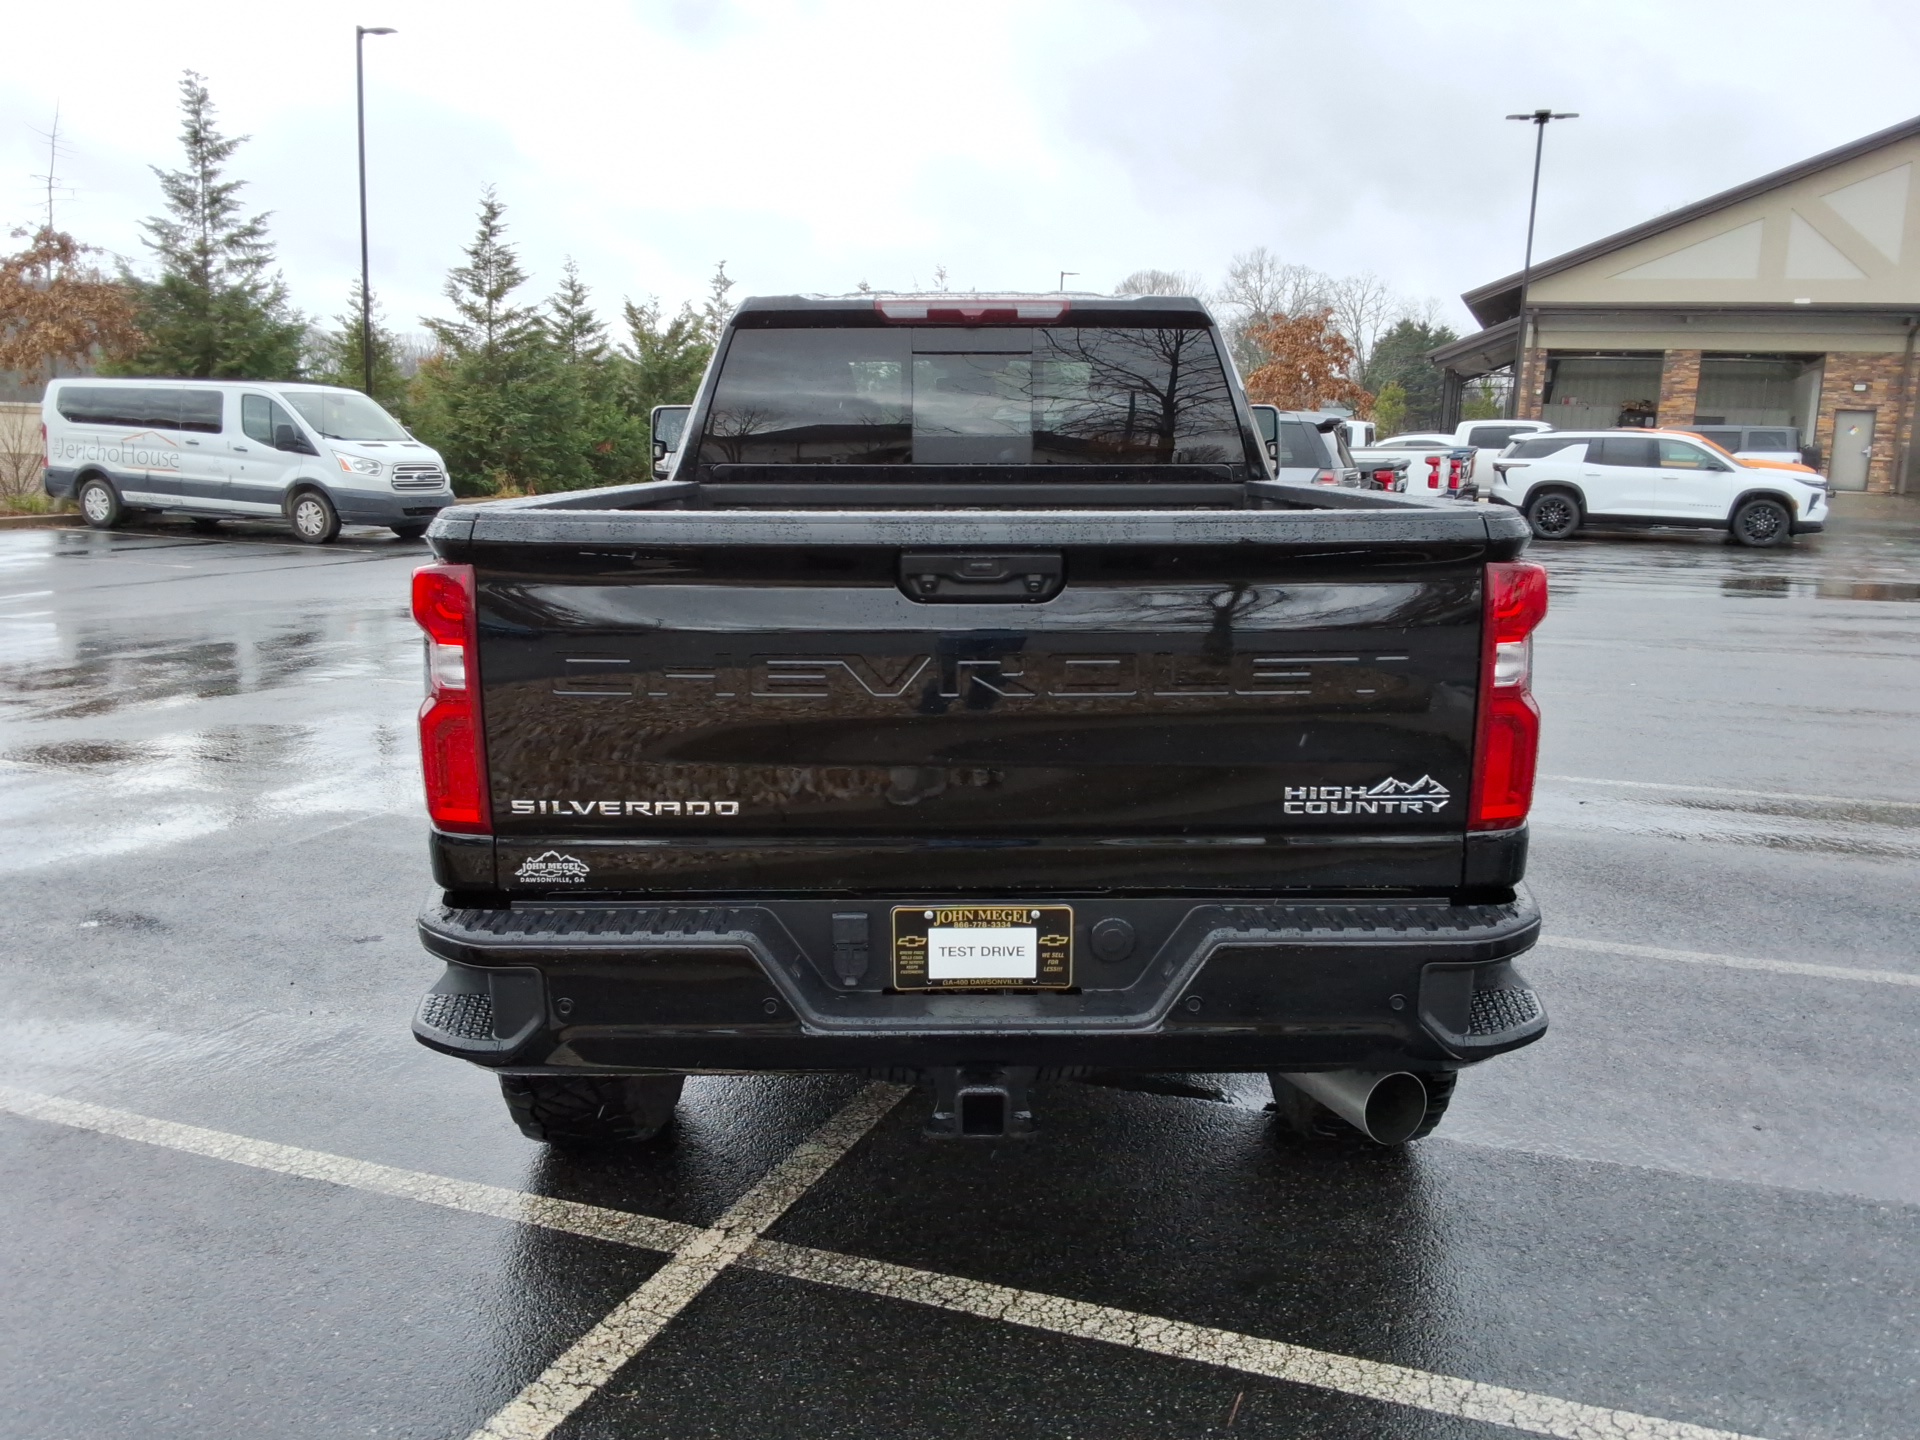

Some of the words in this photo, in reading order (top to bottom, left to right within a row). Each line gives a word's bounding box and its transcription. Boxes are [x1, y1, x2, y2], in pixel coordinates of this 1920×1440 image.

[552, 650, 1410, 697] CHEVROLET
[1284, 786, 1367, 800] HIGH
[511, 799, 740, 816] SILVERADO
[1284, 800, 1449, 814] COUNTRY
[522, 862, 546, 873] JOHN
[547, 862, 581, 871] MEGEL
[520, 876, 572, 884] DAWSONVILLE,
[933, 909, 974, 927] JOHN
[978, 909, 1032, 924] MEGEL
[938, 946, 976, 957] TEST
[980, 946, 1025, 957] DRIVE
[970, 978, 1024, 986] DAWSONVILLE
